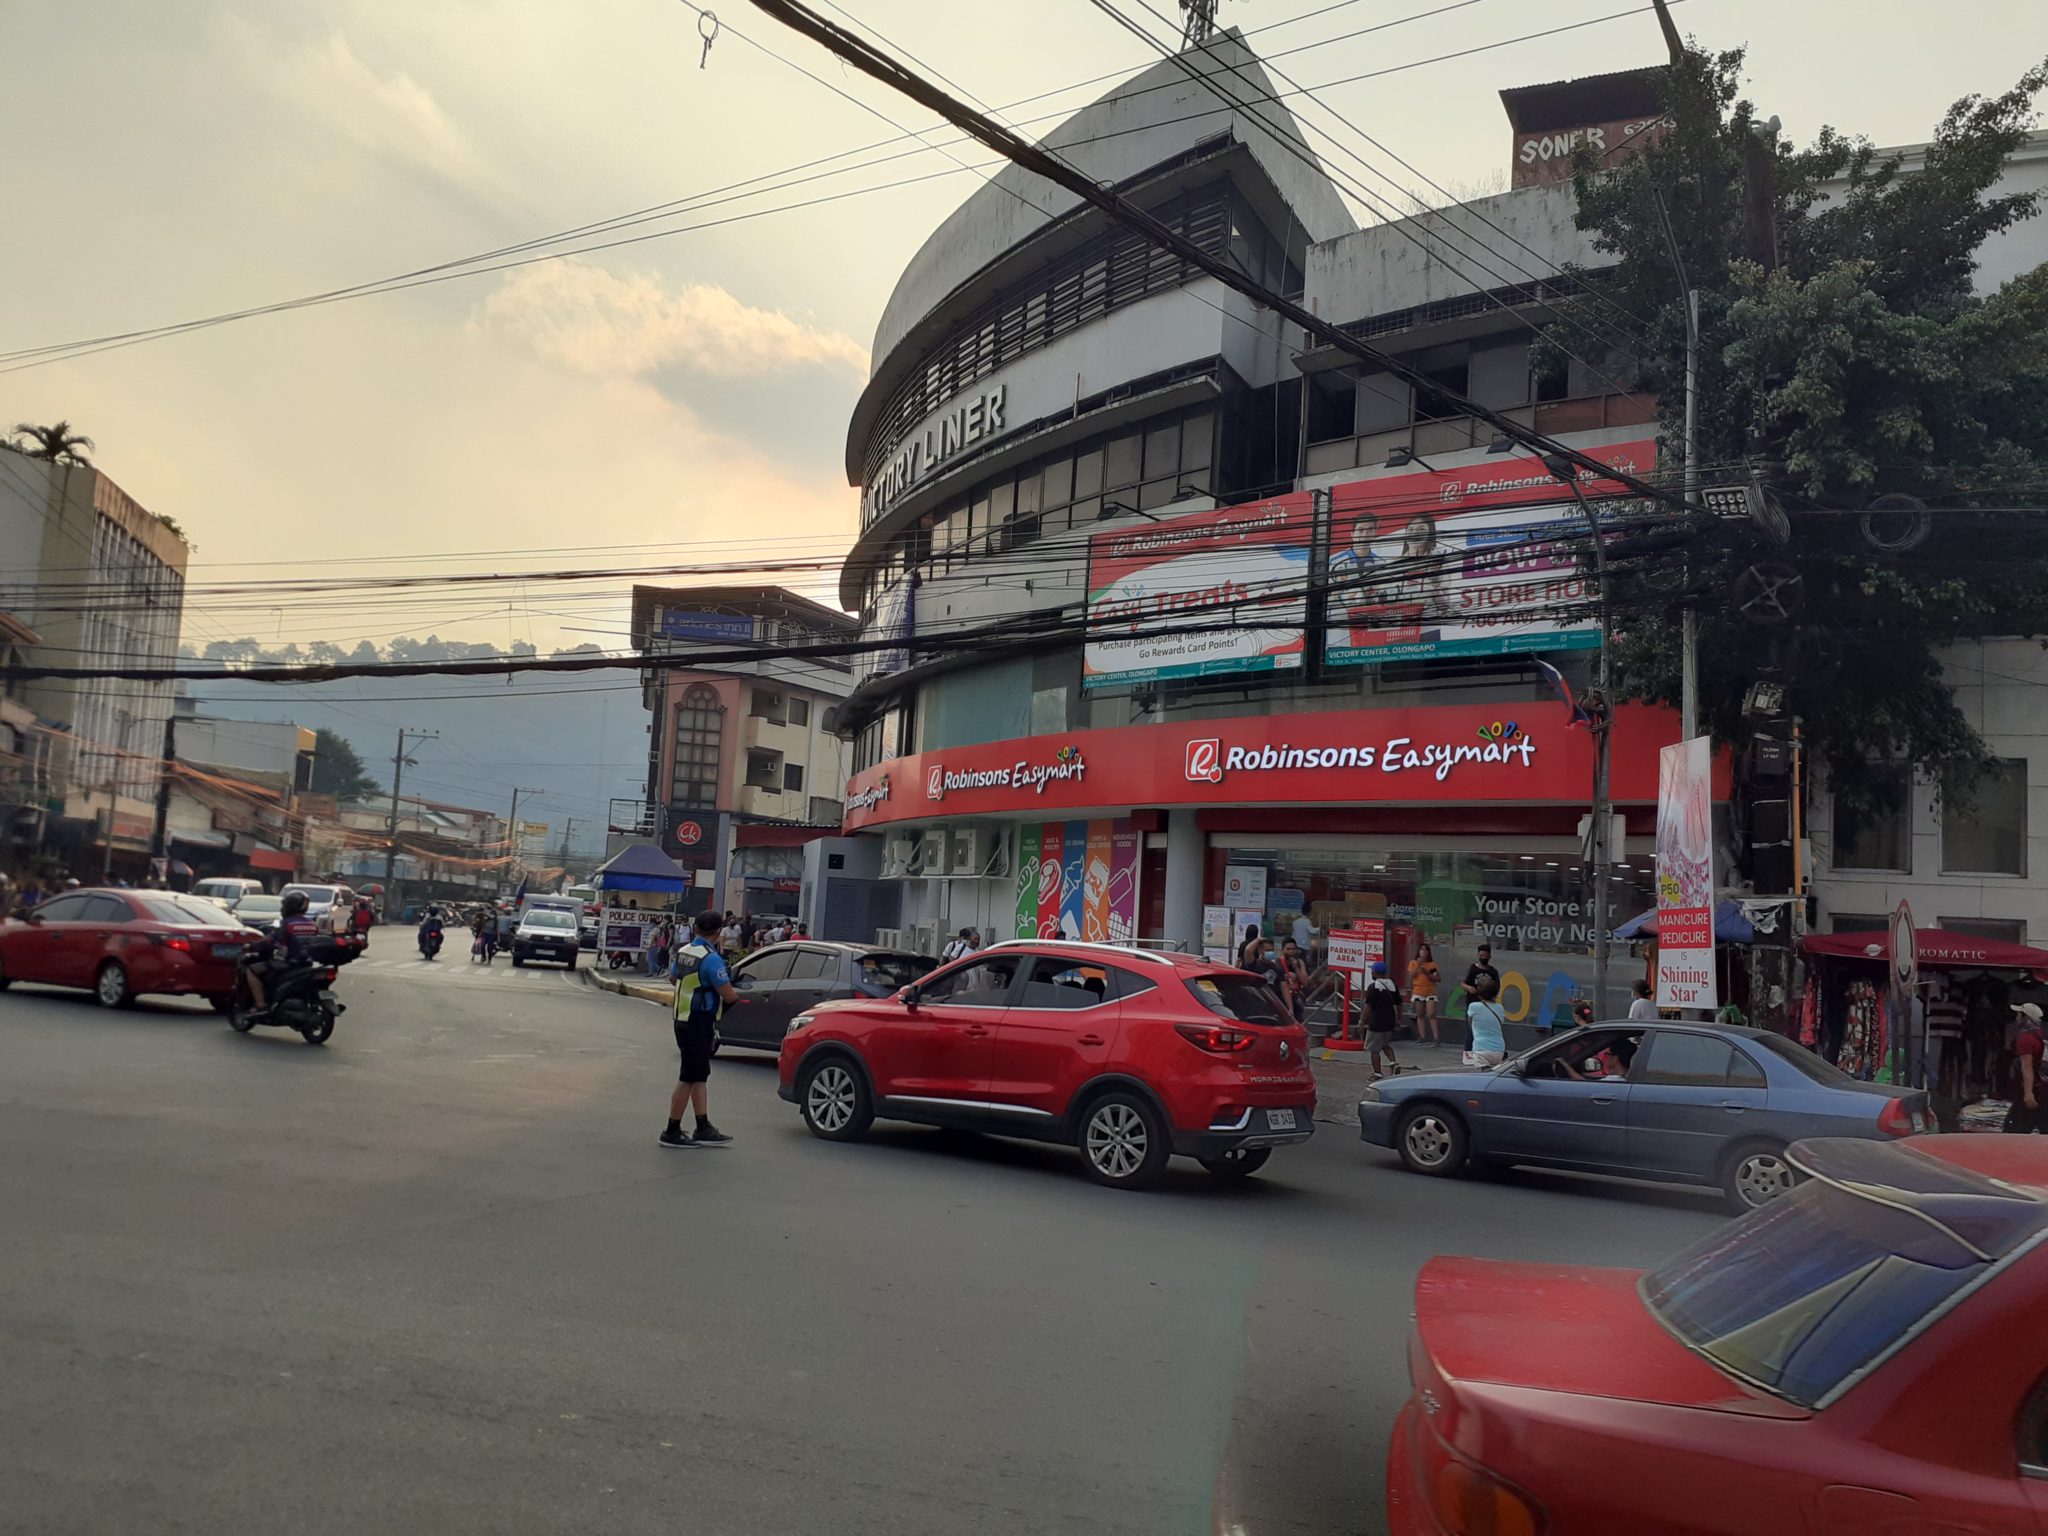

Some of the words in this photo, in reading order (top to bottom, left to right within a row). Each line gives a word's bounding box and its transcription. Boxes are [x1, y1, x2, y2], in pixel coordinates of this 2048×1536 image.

[923, 384, 1006, 472] LINER
[1155, 579, 1249, 616] Treats
[1460, 585, 1537, 609] STORE
[1098, 637, 1132, 651] Purchase
[1138, 649, 1150, 660] Go
[1151, 645, 1185, 657] Rewards
[1187, 643, 1206, 655] Card
[1208, 637, 1239, 651] Points!
[1328, 649, 1359, 659] VICTORY
[1360, 646, 1391, 657] CENTER,
[1392, 643, 1436, 654] OLONGAPO
[1085, 674, 1107, 682] VICTORY
[1128, 668, 1158, 678] OLONGAPO
[1225, 743, 1376, 771] Robinsons
[1381, 735, 1536, 781] Easymart
[944, 767, 1011, 791] Robinsons
[1012, 755, 1085, 795] Easymart
[1660, 881, 1680, 897] P50
[1474, 895, 1520, 915] Your
[1525, 896, 1579, 918] Store
[1585, 897, 1617, 918] fr
[609, 911, 637, 922] POLICE
[1658, 911, 1710, 927] MANICURE
[1473, 919, 1564, 945] Everyday
[1661, 930, 1707, 944] PEDICURE
[1329, 946, 1364, 957] PARKING
[1336, 954, 1357, 963] AREA
[1680, 951, 1688, 961] IS
[1660, 965, 1710, 988] Shining
[1669, 984, 1699, 1003] Star
